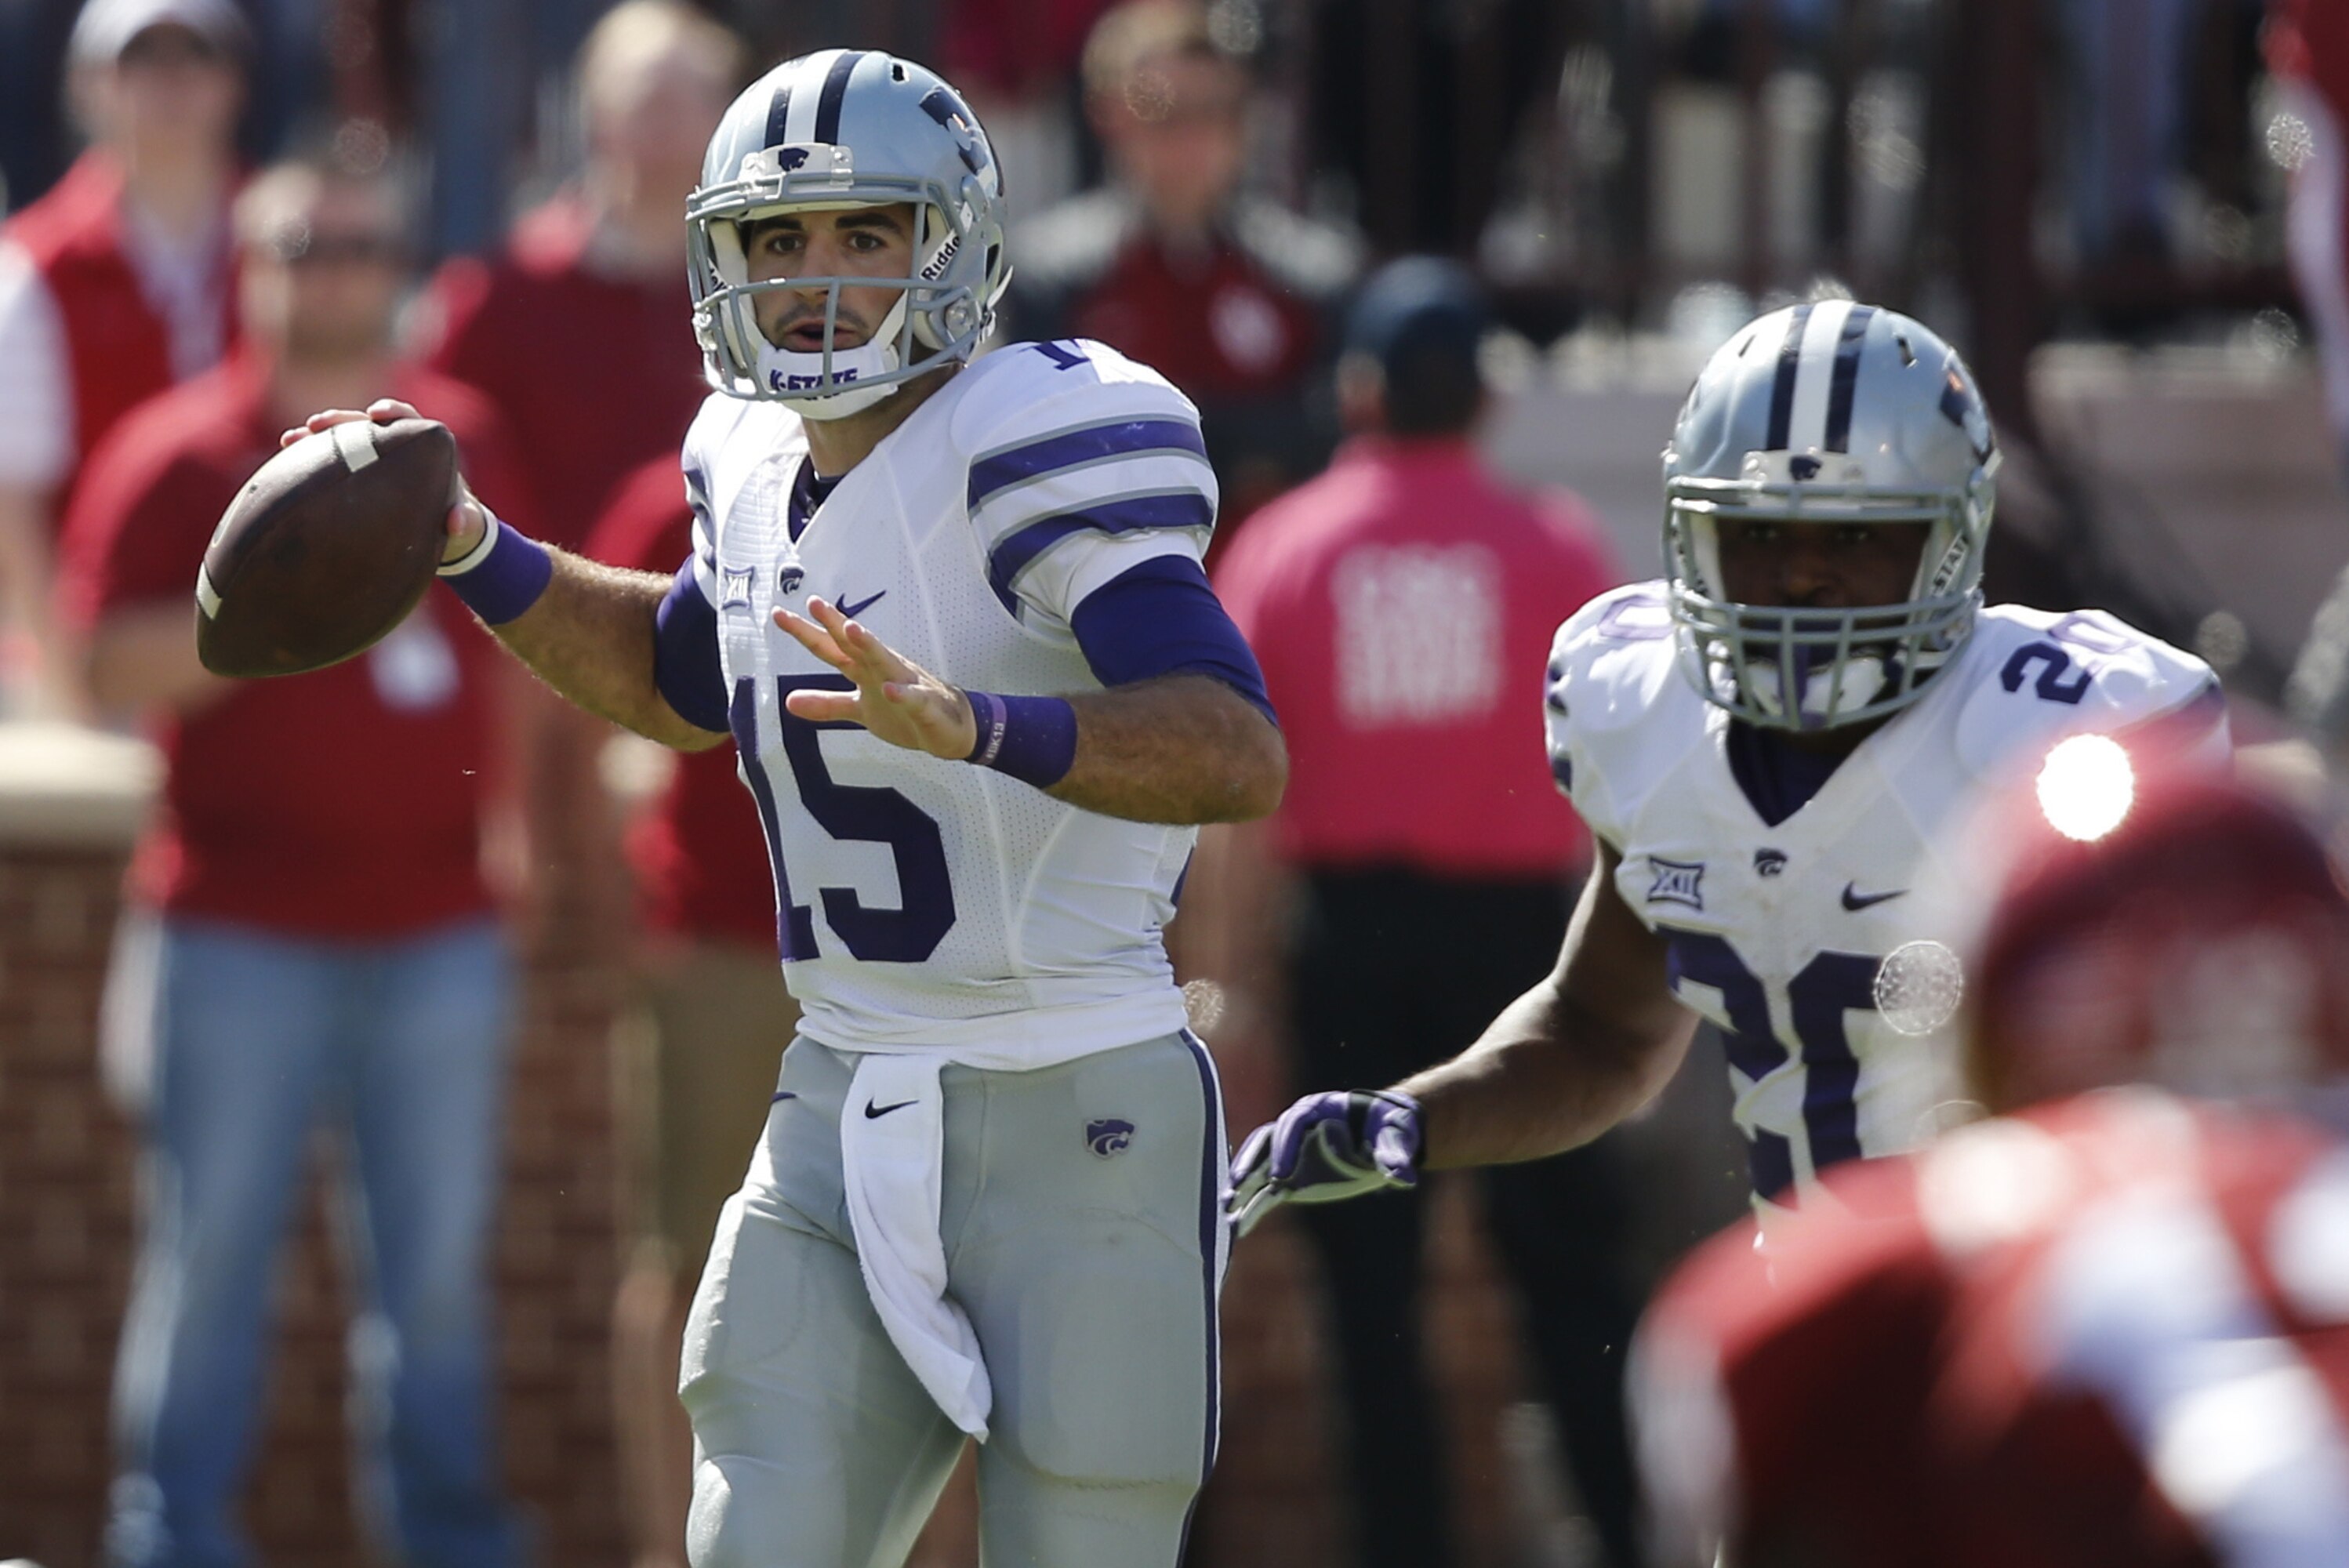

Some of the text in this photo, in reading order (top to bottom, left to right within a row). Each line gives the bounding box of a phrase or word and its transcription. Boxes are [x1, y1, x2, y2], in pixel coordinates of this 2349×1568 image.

[920, 235, 960, 281] Ridde
[1032, 337, 1091, 371] 1
[728, 673, 957, 963] 15
